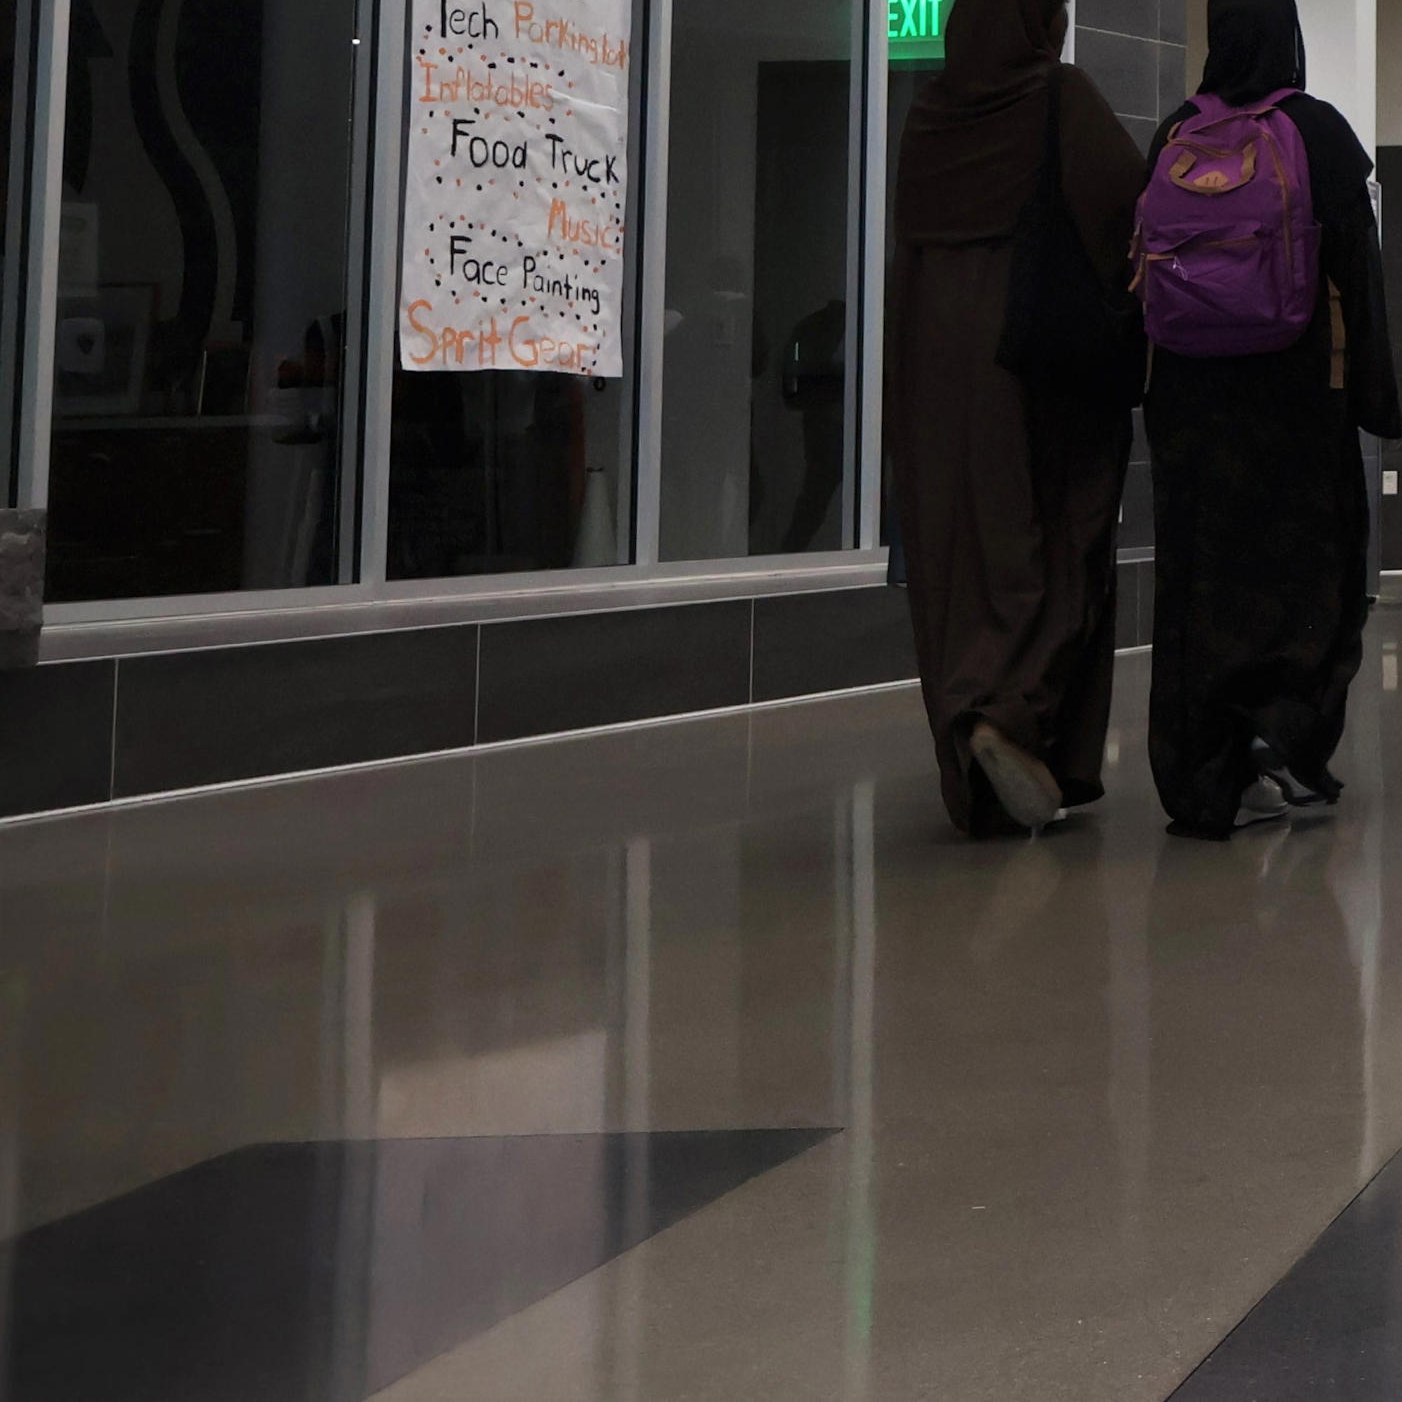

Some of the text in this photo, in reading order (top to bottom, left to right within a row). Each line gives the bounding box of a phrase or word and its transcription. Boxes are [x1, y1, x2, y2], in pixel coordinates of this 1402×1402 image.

[514, 0, 598, 64] Parking
[418, 61, 553, 112] Inflatables
[451, 119, 620, 184] Food Truck
[450, 235, 600, 315] Face Painting
[508, 315, 592, 368] Gear
